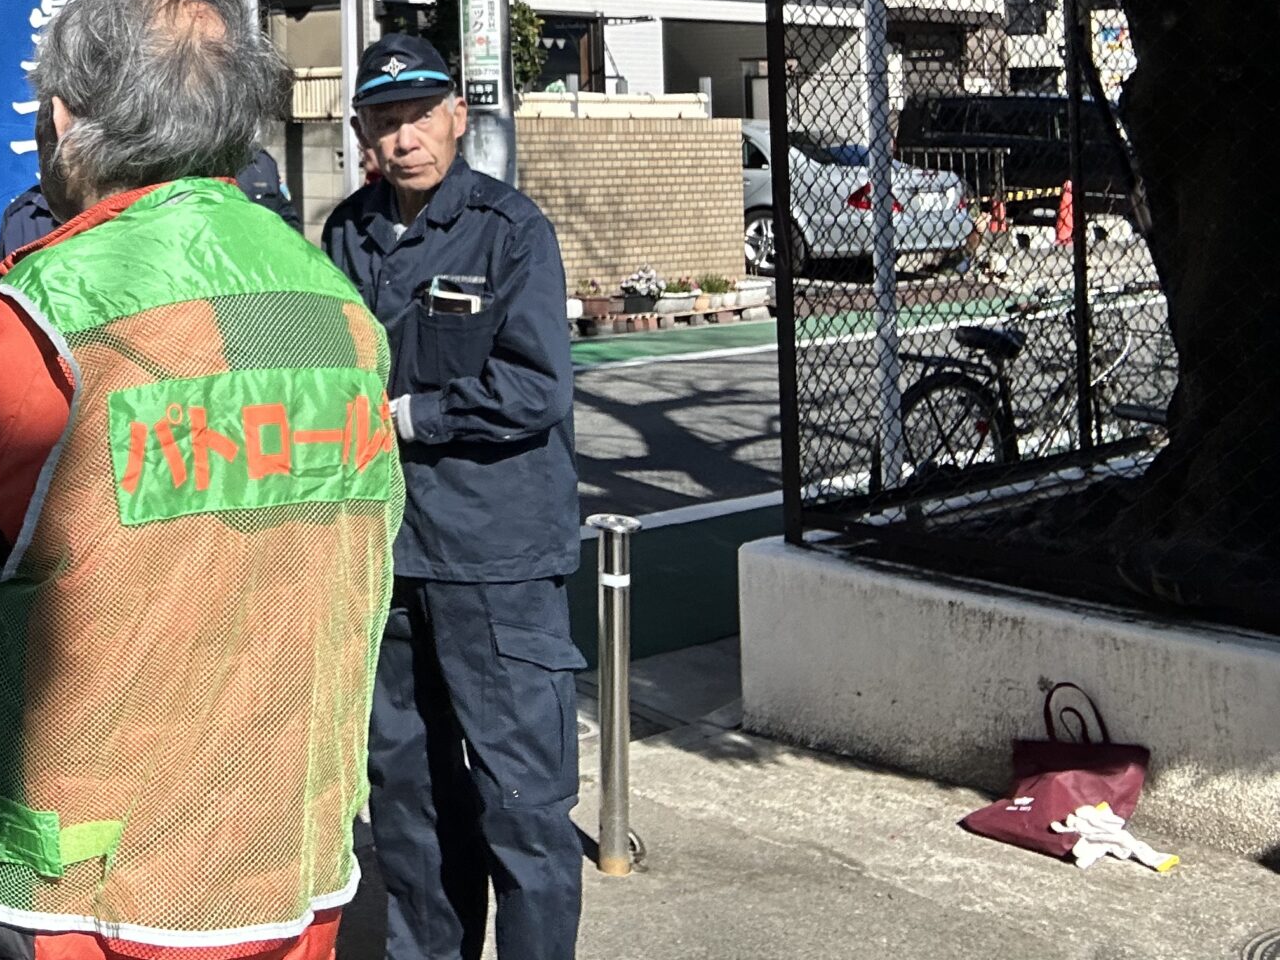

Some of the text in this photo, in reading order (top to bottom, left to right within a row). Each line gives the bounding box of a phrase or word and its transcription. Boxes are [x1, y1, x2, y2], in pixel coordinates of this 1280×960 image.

[121, 389, 393, 495] パトロール
